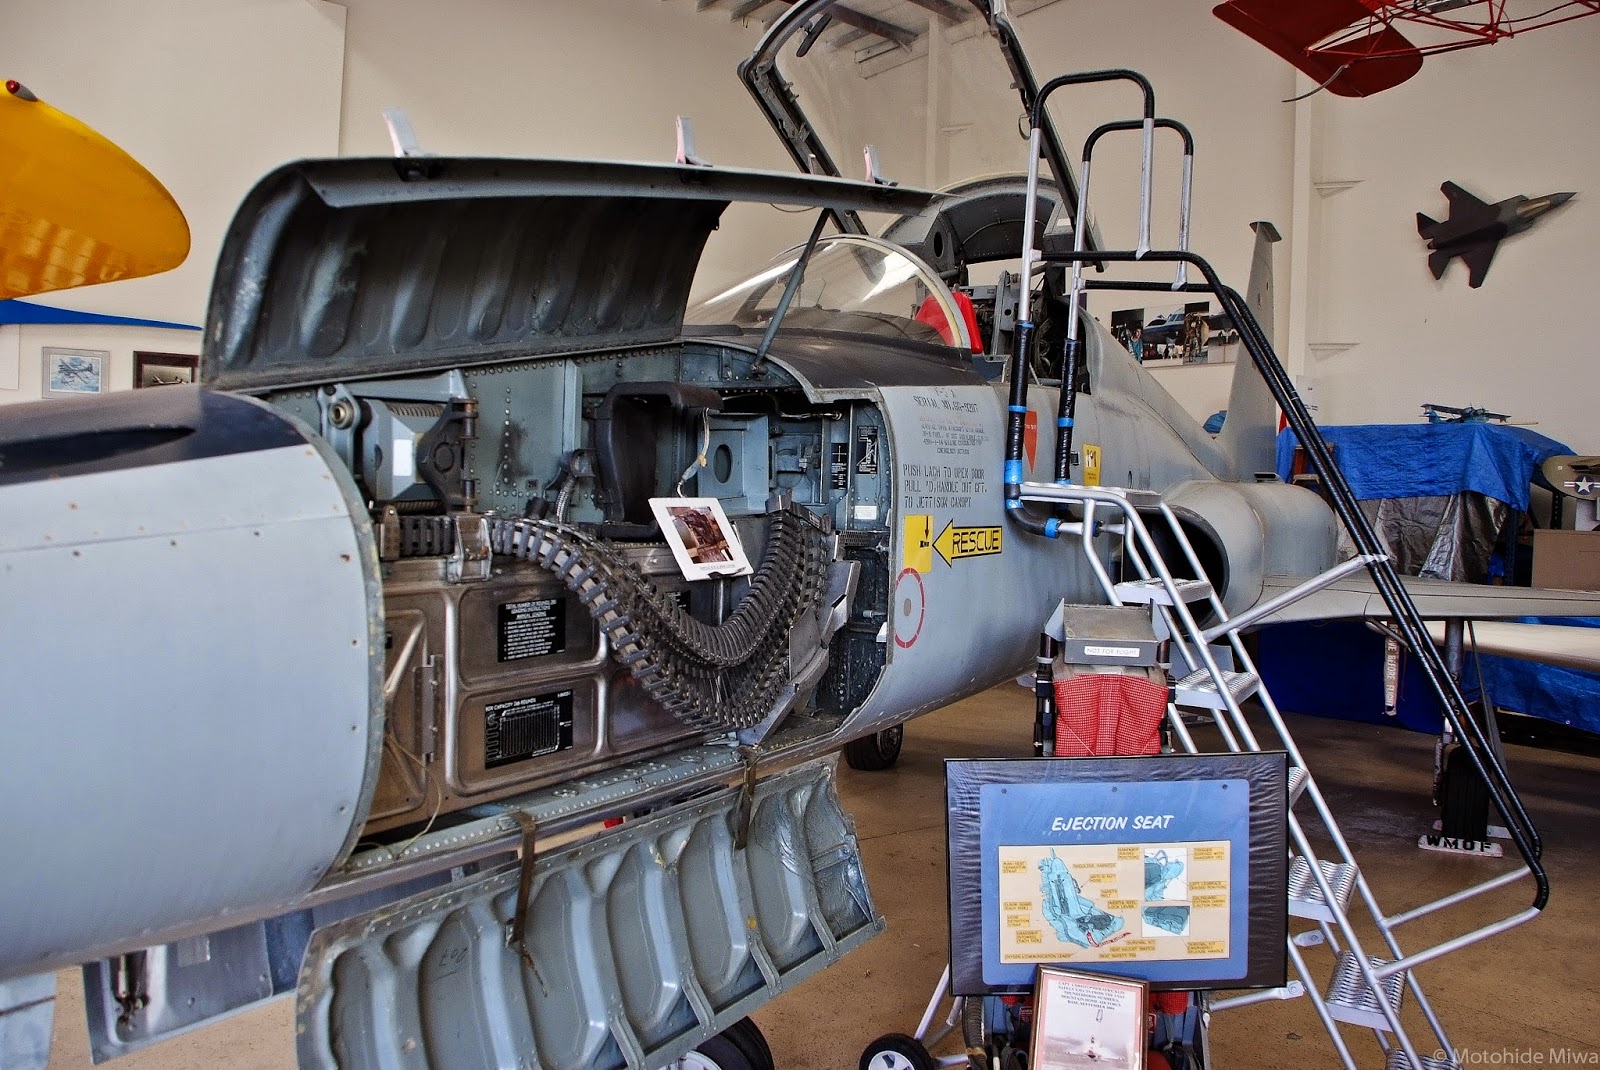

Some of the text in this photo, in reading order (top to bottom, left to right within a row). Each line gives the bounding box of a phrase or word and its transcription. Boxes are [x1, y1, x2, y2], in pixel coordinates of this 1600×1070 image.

[903, 464, 920, 476] PUSH
[944, 466, 952, 478] TO
[954, 467, 968, 479] OPEN
[972, 468, 984, 480] DOOR
[904, 480, 921, 492] PULL
[962, 482, 972, 492] OUT
[904, 496, 912, 508] TO
[916, 496, 948, 508] JETTISON
[952, 530, 1000, 554] RESCUE
[1387, 655, 1398, 680] BEFORE
[1385, 684, 1395, 706] FLIGHT
[1052, 815, 1174, 832] EJECTION SEAT
[1426, 836, 1492, 852] WMOF
